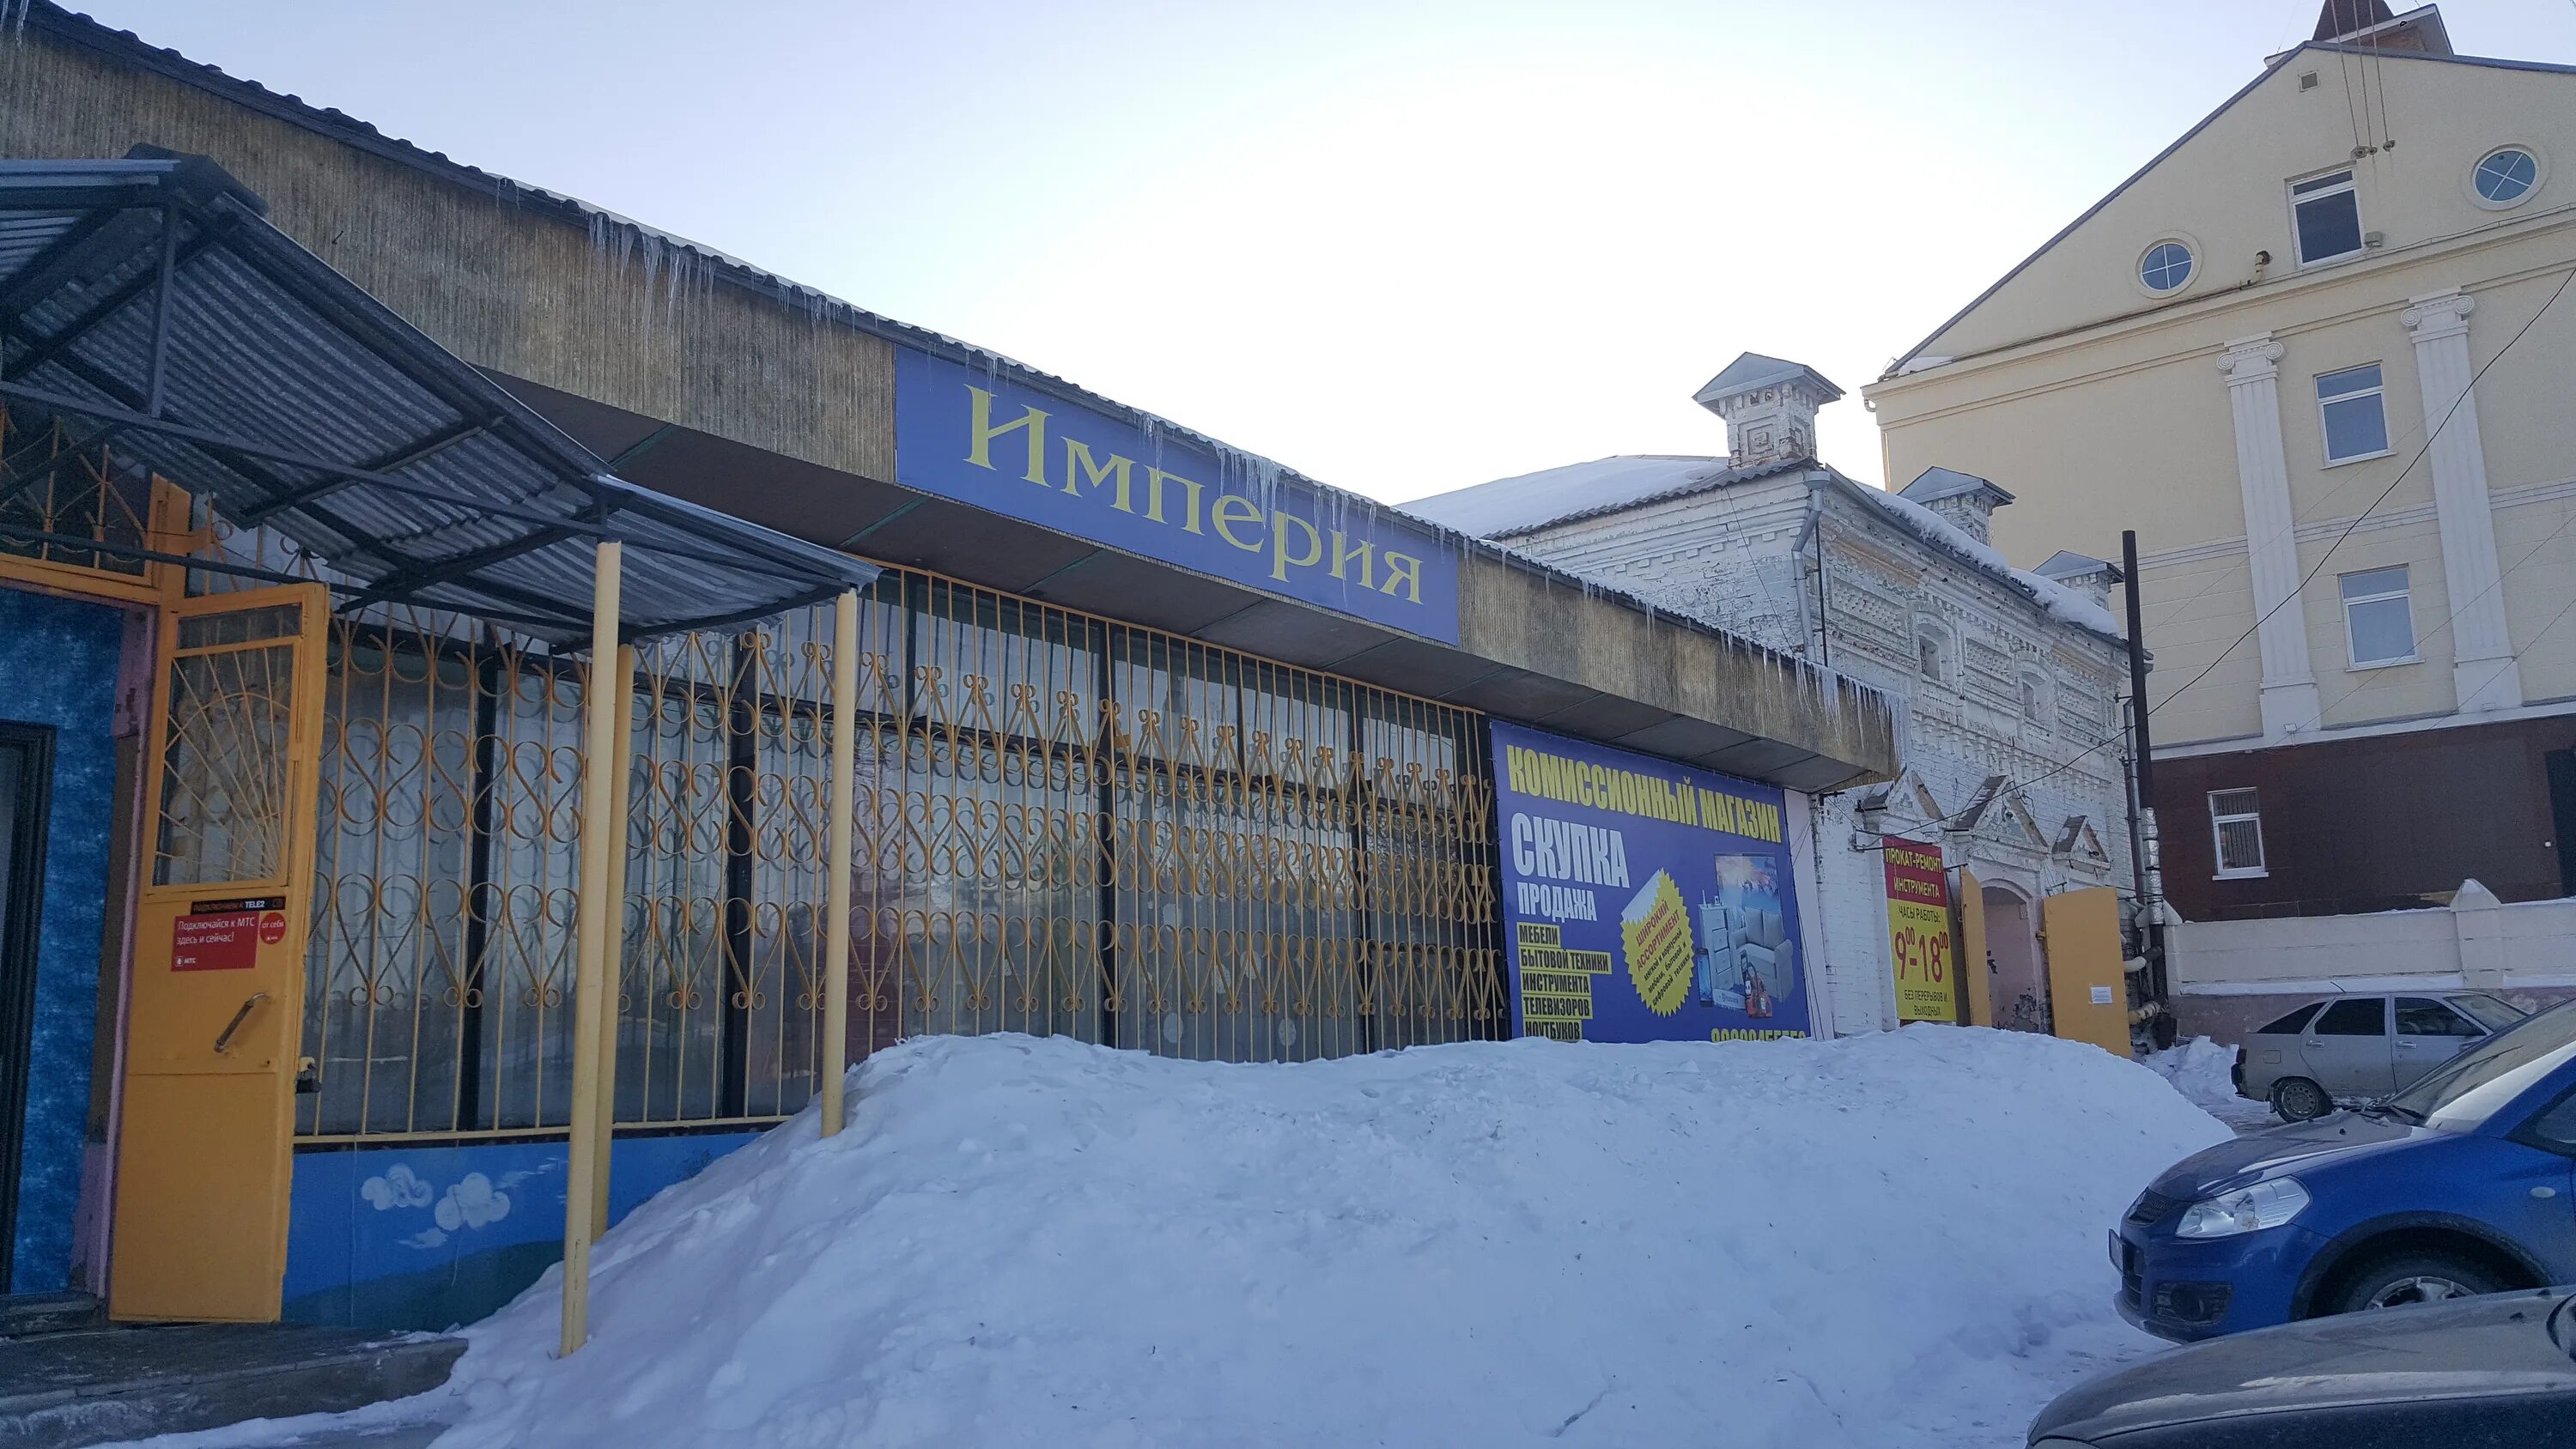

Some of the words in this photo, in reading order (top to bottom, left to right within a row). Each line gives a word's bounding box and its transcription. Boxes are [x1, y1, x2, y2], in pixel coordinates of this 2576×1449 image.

[963, 384, 1424, 605] Империя
[1506, 744, 1698, 827] КОМИССИОННЫЙ
[1698, 787, 1782, 844] МАГАЗИН
[1511, 812, 1630, 888] СКУПКА
[1885, 847, 1941, 873] ПРОКАТ-РЕМОНТ
[1893, 876, 1941, 898] ИНСТРУМЕНТА
[1516, 882, 1597, 923] ПРОДАЖА
[1899, 905, 1916, 919] ЧАСЫ
[178, 919, 229, 931] Подключайся
[237, 917, 255, 927] МТС
[1636, 898, 1669, 947] ШИРОКИЙ
[177, 937, 197, 946] здесь
[205, 931, 234, 943] сейчас!
[1519, 925, 1558, 945] МЕБЕЛИ
[1637, 909, 1680, 971] АССОРТИМЕНТ
[1521, 949, 1569, 970] БЫТОВОЙ
[1570, 952, 1609, 972] ТЕХНИКИ
[1522, 973, 1589, 993] ИНСТРУМЕНТА
[1523, 997, 1590, 1016] ТЕЛЕВИЗОРОВ
[1525, 1021, 1581, 1040] НОУТБУКОВ
